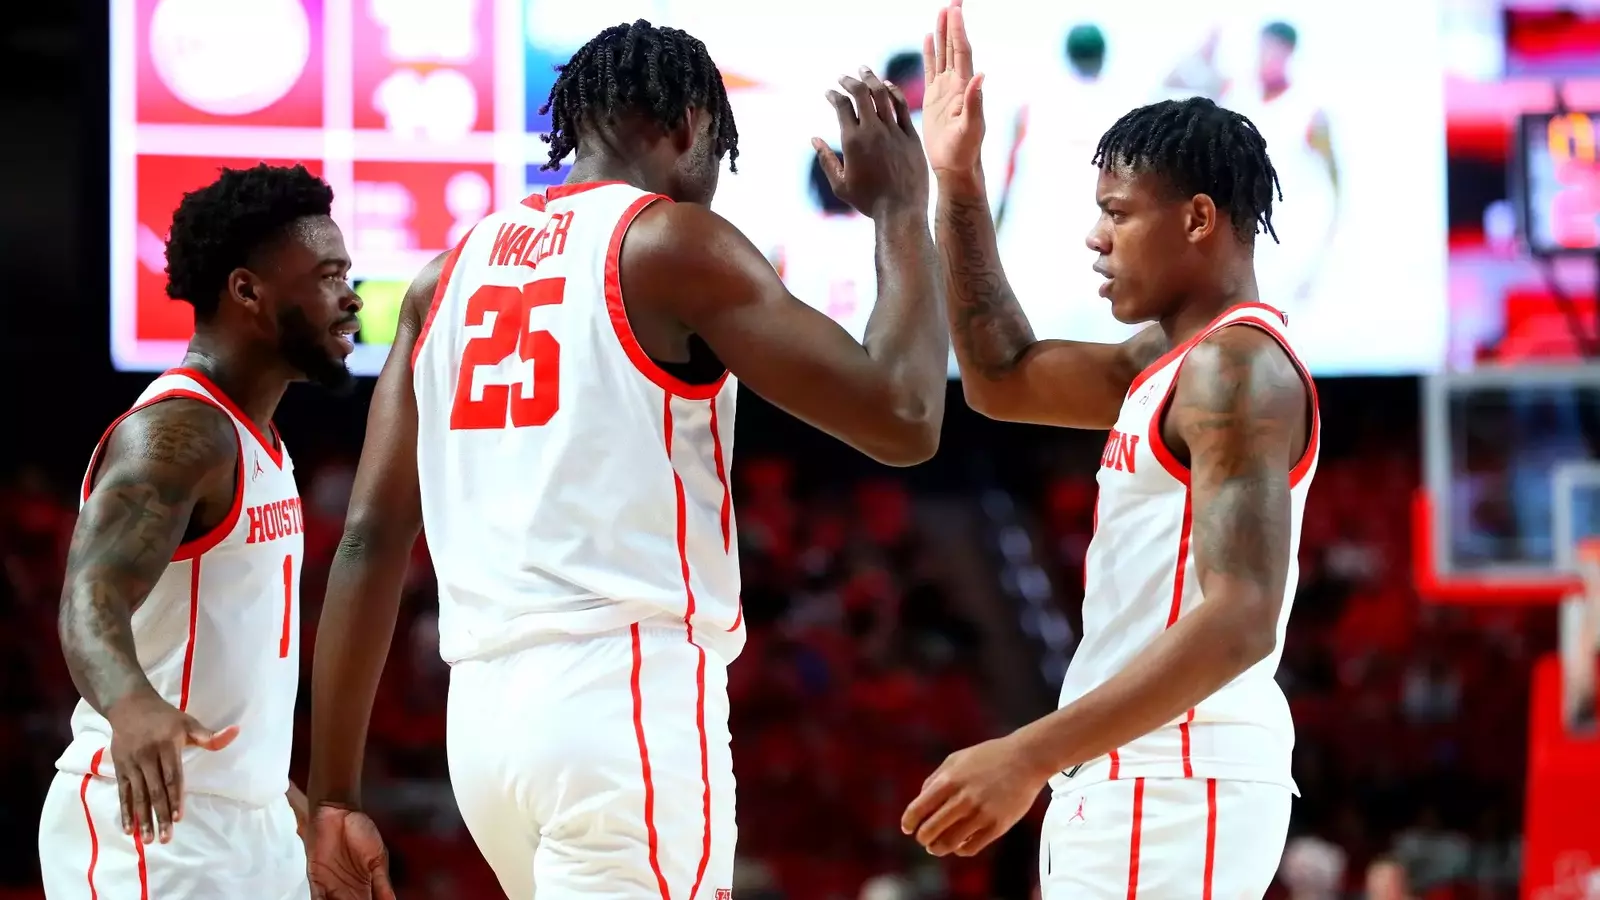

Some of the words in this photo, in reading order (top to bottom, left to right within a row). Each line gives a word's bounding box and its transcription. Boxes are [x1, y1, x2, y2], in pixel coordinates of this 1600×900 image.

[488, 210, 574, 269] WALER
[450, 277, 566, 430] 25
[279, 554, 292, 658] 1
